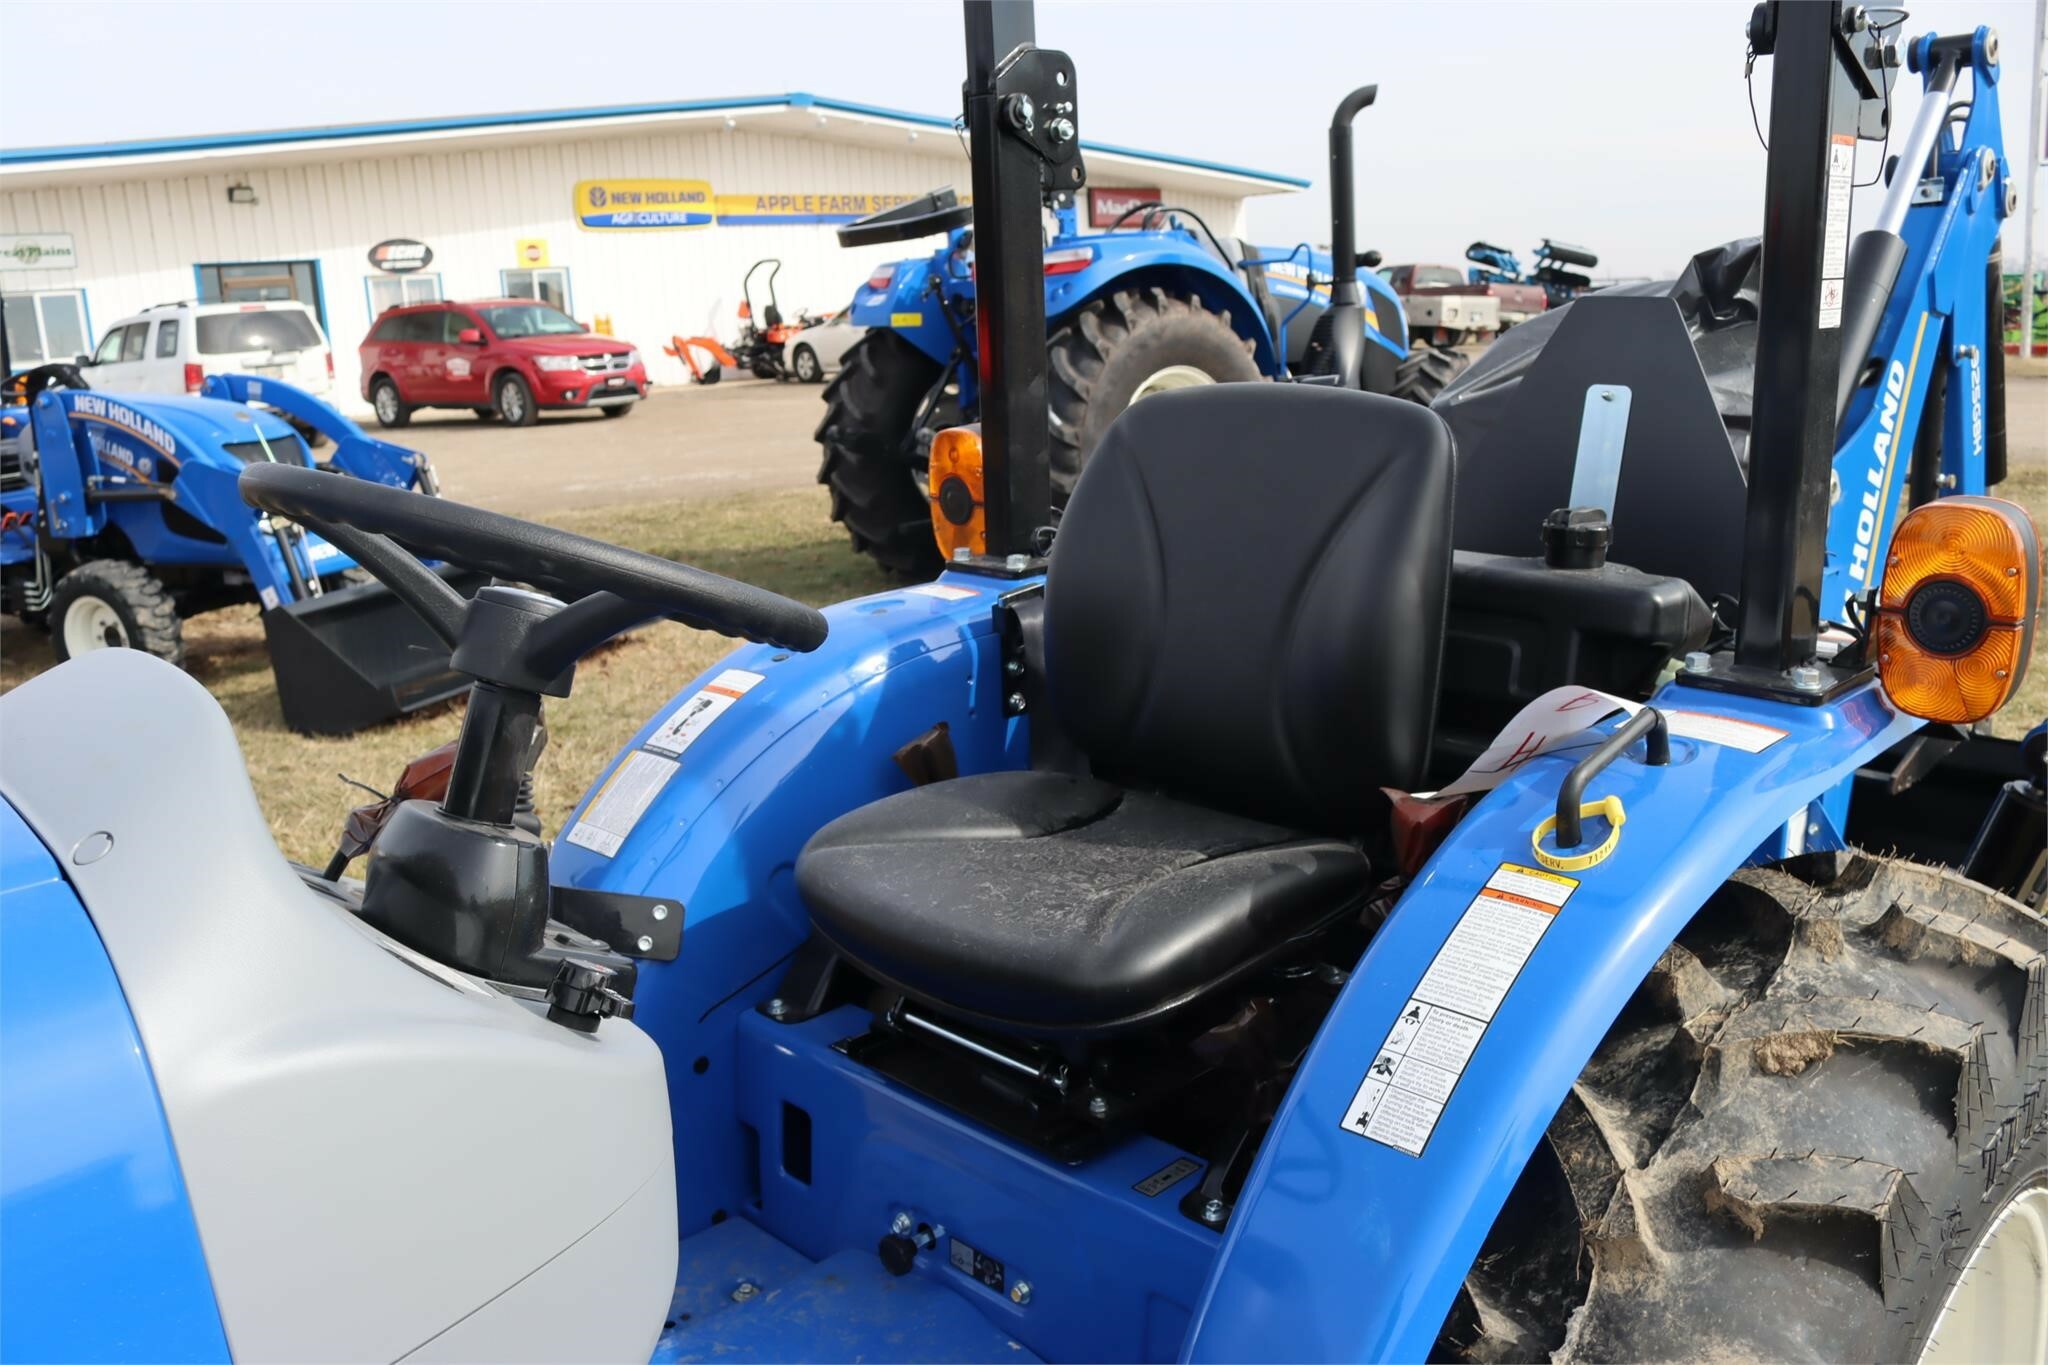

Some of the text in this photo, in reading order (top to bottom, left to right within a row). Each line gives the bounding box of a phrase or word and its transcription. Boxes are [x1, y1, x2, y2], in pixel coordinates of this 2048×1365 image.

[611, 191, 705, 204] NEW HOLLAND
[756, 196, 808, 211] APPLE
[818, 195, 865, 211] FARM
[74, 395, 176, 455] NEW HOLLAND
[1850, 360, 1905, 581] HOLLAND
[1508, 895, 1542, 909] WARNING
